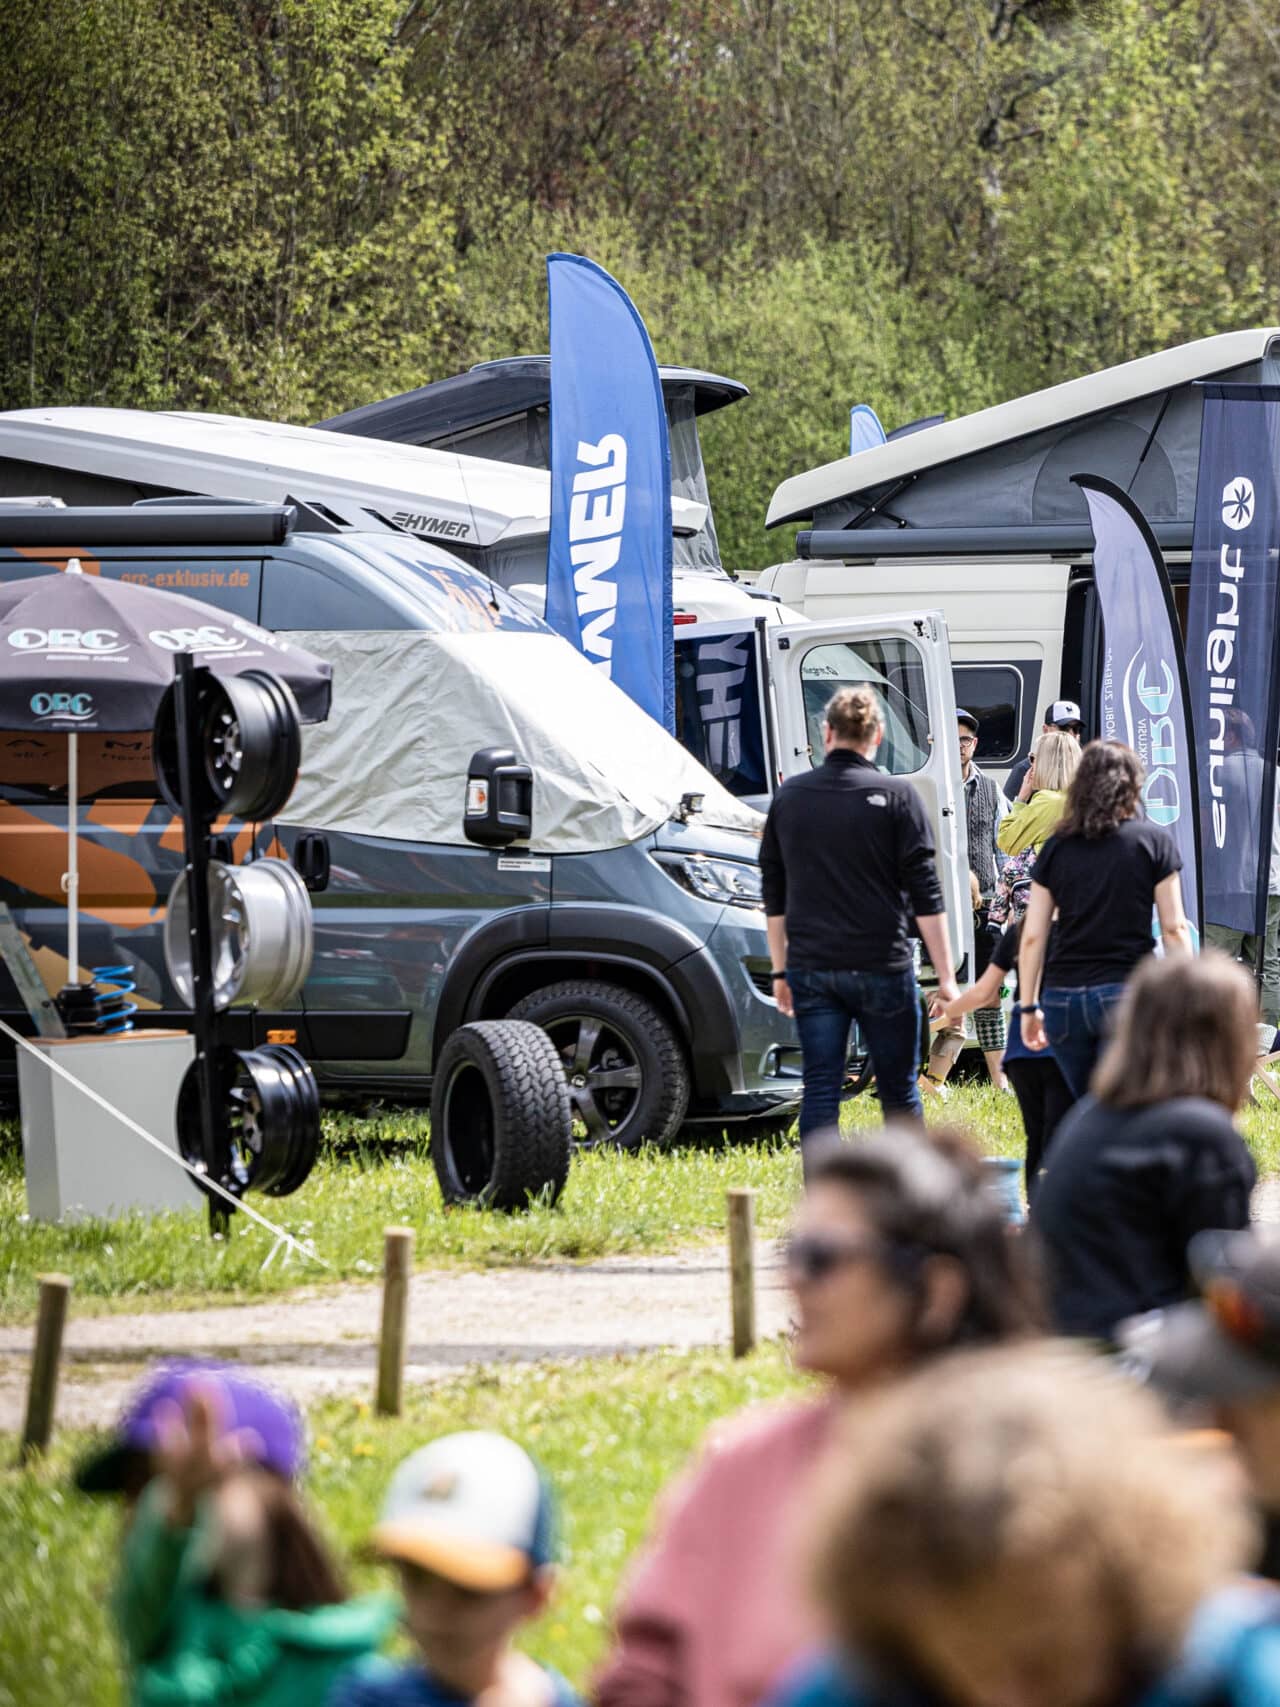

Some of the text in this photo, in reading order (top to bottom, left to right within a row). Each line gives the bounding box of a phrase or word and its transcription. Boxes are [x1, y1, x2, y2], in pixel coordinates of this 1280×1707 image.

[403, 513, 471, 539] HYMER
[7, 627, 121, 650] ORC
[29, 692, 94, 716] ORC
